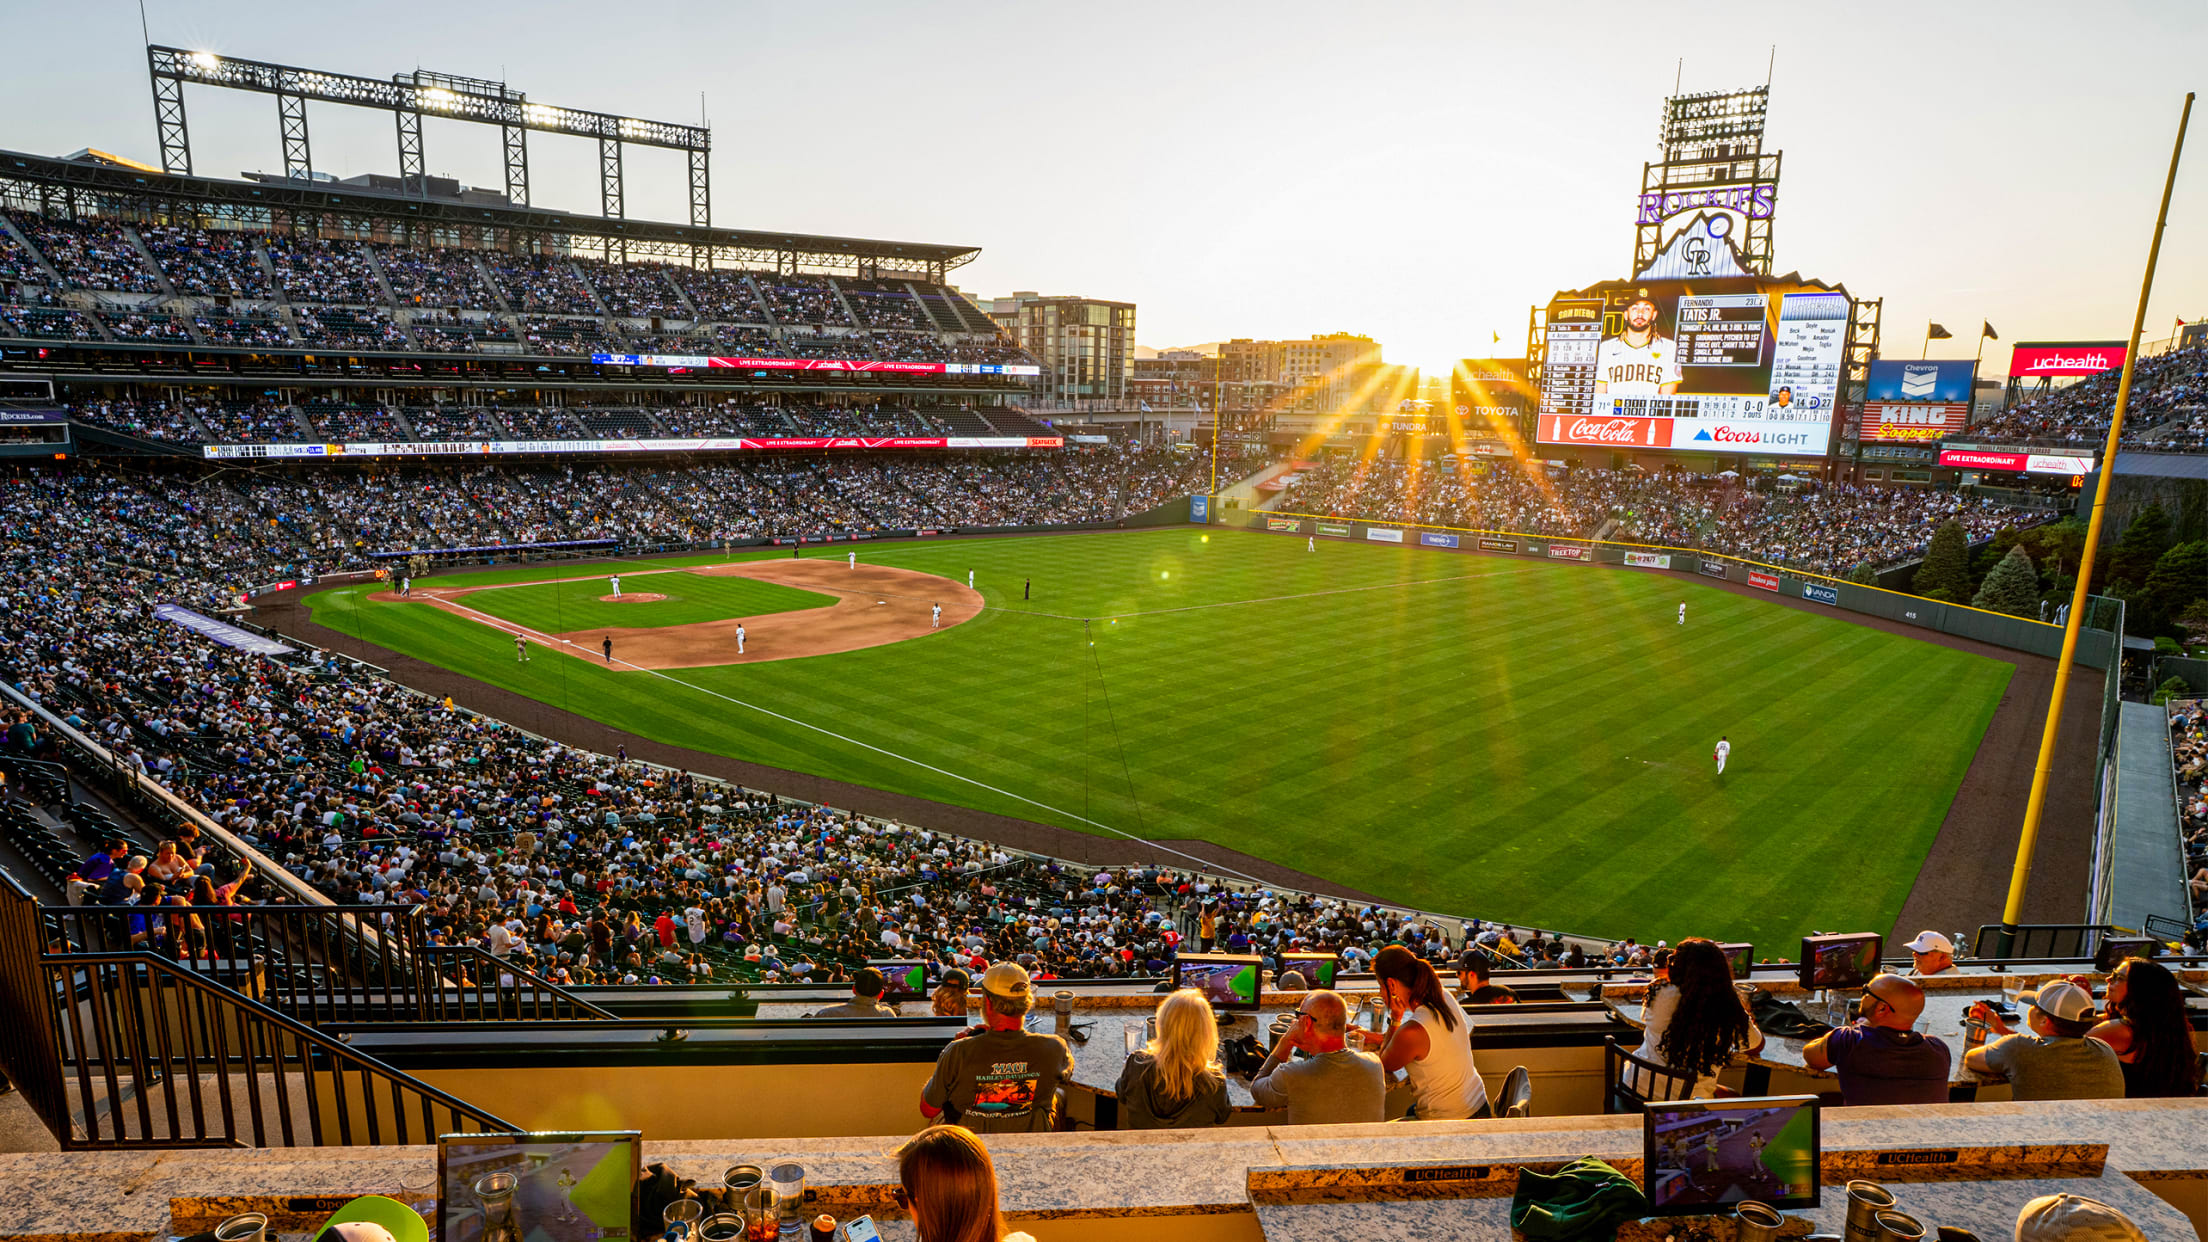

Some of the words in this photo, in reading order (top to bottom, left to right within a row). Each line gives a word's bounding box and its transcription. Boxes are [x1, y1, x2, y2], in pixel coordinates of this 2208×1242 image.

[1636, 186, 1774, 224] ROCKIES
[1558, 309, 1573, 320] SAN
[1574, 308, 1596, 319] DIEGO
[1682, 308, 1708, 321] TATIS
[1708, 308, 1722, 320] JR.
[1904, 364, 1938, 372] Chevron
[2033, 354, 2107, 370] uchealth
[1608, 364, 1662, 384] PADRES
[1474, 406, 1519, 416] TOYOTA
[1880, 406, 1946, 424] KING
[1392, 422, 1426, 432] TUNDRA
[1877, 423, 1944, 441] Soopers
[1714, 426, 1760, 442] Coors
[1762, 432, 1808, 445] LIGHT
[1947, 454, 1960, 462] LIVE
[1962, 456, 2016, 465] EXTRAORDINARY
[1906, 611, 1917, 619] 415
[991, 1062, 1028, 1074] MAUI
[1888, 1152, 1947, 1164] UCHealth
[1416, 1166, 1478, 1180] UCHealth
